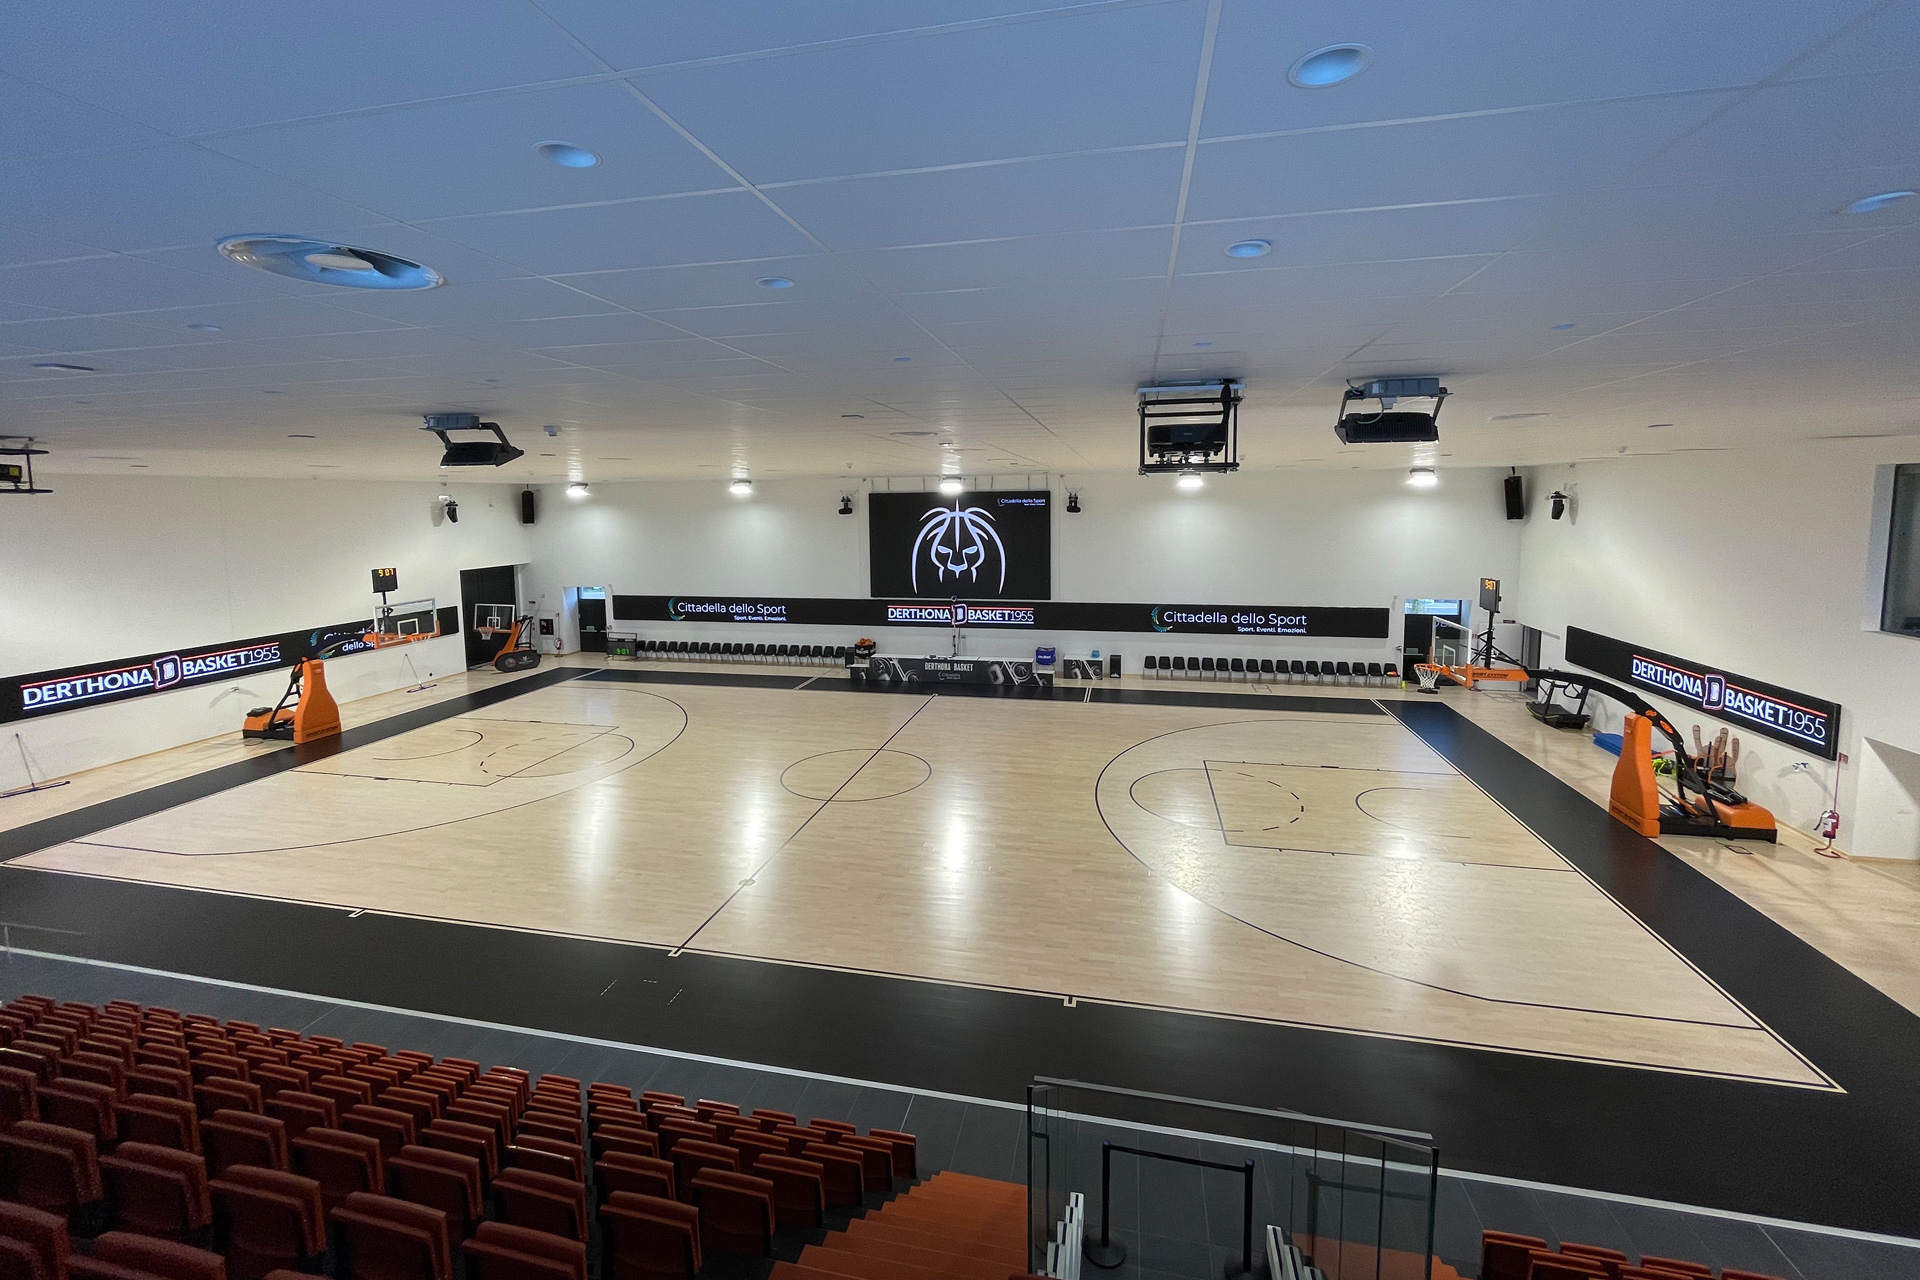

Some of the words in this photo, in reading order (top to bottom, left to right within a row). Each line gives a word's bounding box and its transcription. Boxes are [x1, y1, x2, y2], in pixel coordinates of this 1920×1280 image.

[677, 602, 727, 613] Cittadella
[728, 603, 755, 613] dello
[757, 604, 787, 616] Sport
[888, 608, 950, 620] DERTHONA
[1163, 611, 1228, 623] Cittadella
[1231, 612, 1265, 624] dello
[1268, 613, 1308, 626] Sport
[342, 641, 364, 652] dello
[953, 662, 973, 672] BASKET
[1632, 658, 1703, 697] DERTHONA
[22, 668, 154, 705] DERTHONA
